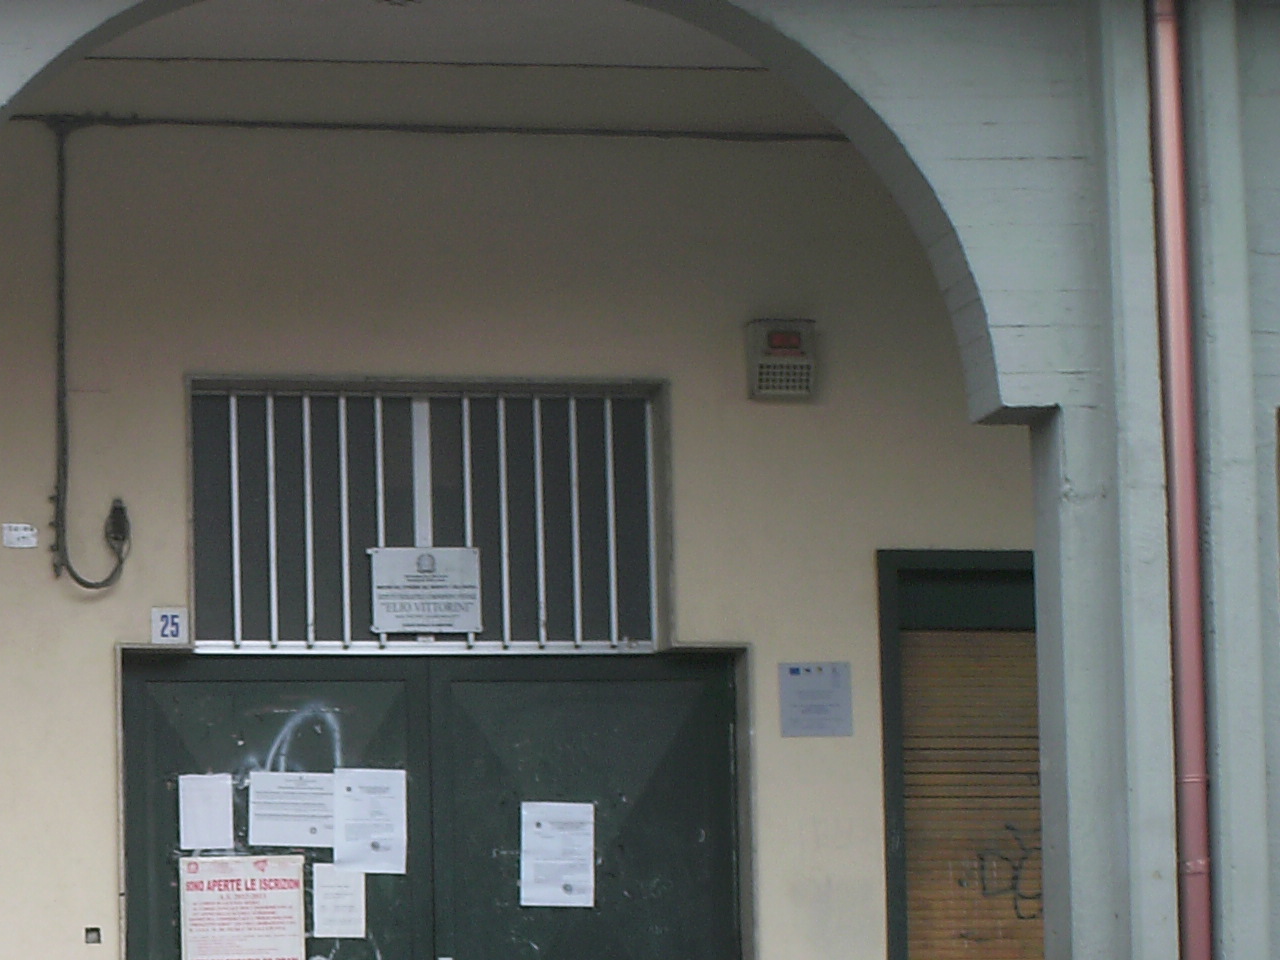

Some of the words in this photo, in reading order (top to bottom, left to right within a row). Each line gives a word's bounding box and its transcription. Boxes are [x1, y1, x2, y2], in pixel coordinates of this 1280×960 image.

[160, 614, 180, 638] 25
[207, 879, 242, 892] APERTE
[245, 878, 257, 891] LE
